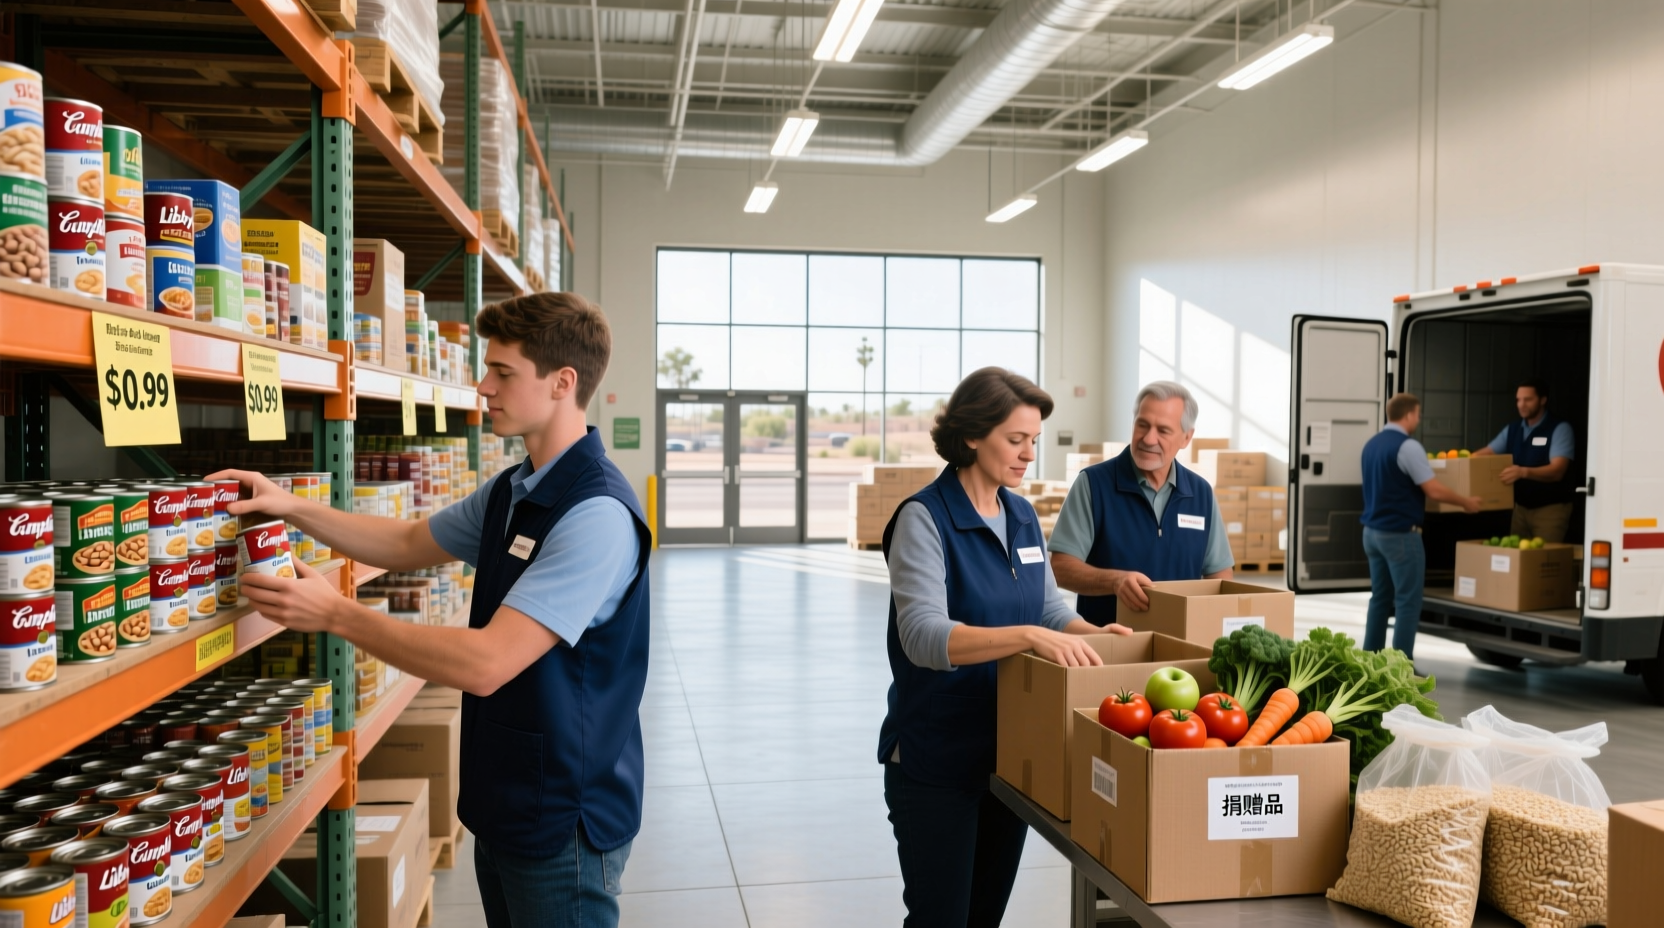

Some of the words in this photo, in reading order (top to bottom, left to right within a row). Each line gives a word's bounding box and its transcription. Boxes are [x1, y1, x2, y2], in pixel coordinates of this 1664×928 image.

[105, 364, 169, 411] $0.99
[1222, 793, 1283, 817] 捐赠品
